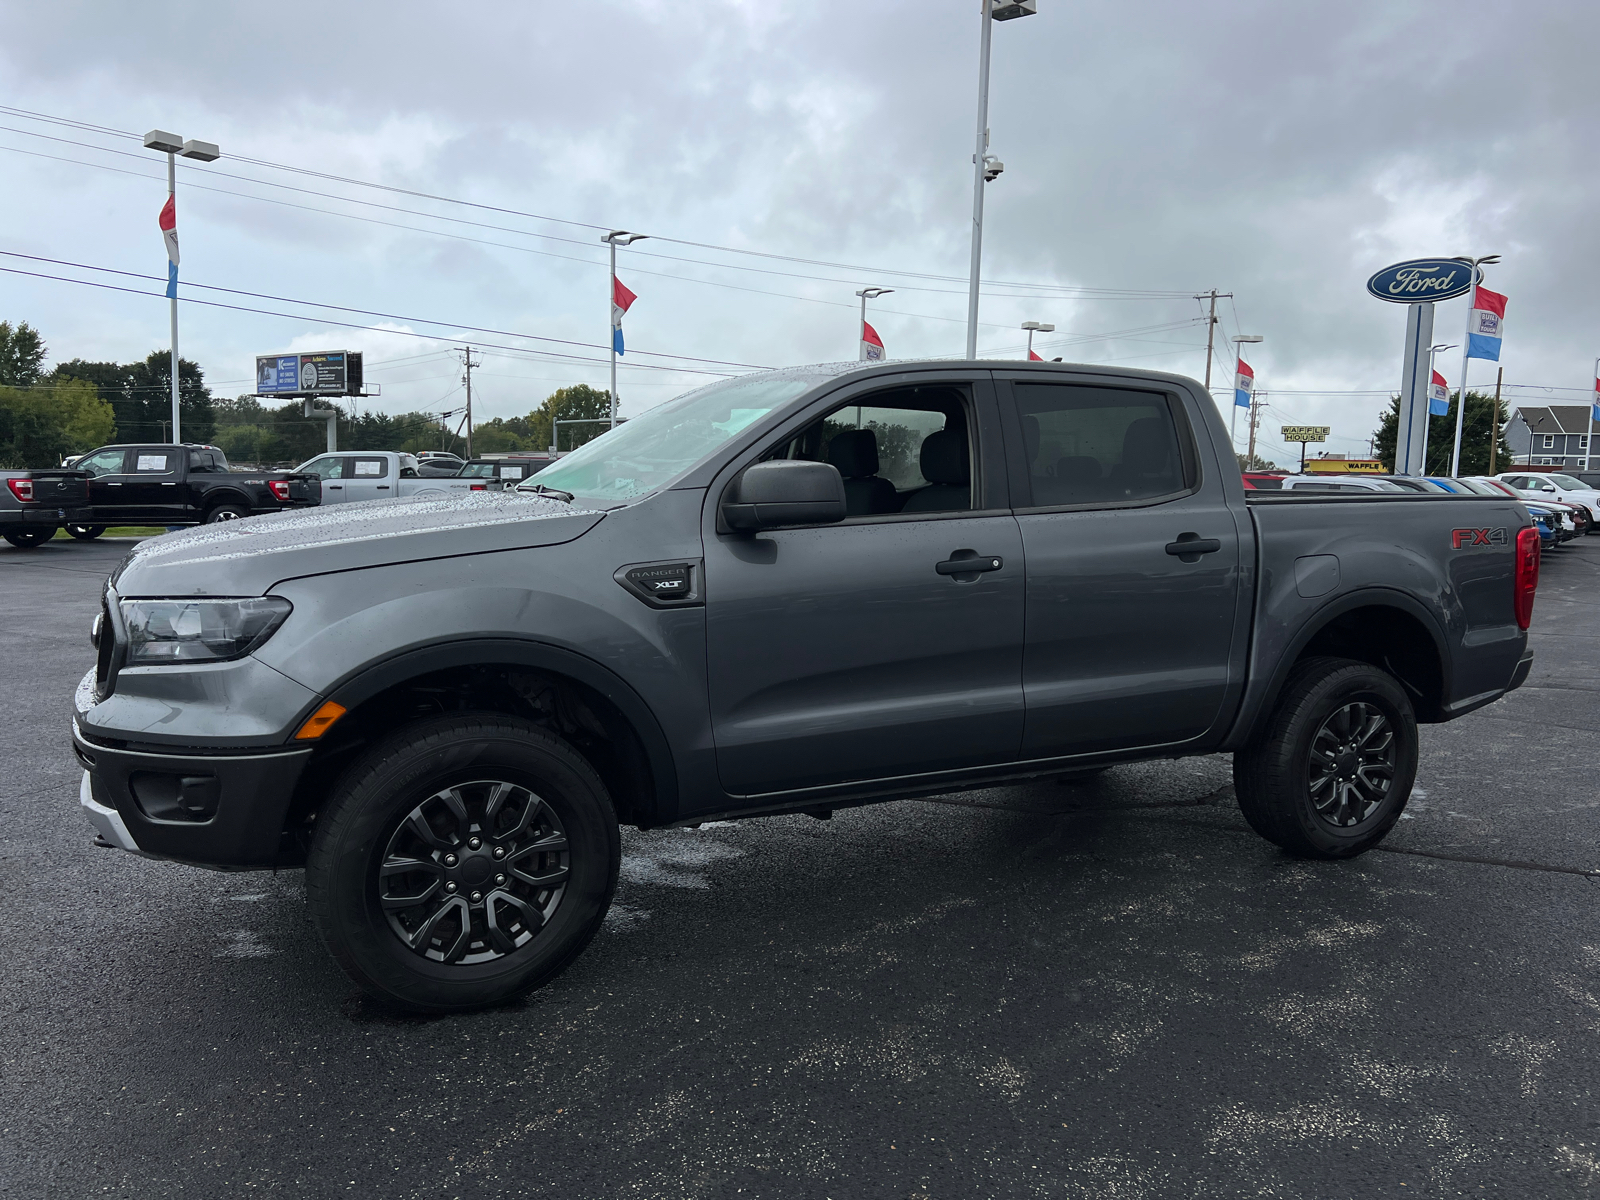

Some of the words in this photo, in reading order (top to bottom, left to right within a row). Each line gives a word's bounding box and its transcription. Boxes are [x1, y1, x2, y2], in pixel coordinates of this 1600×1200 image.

[1389, 266, 1457, 294] Ford
[1481, 313, 1498, 322] BUILT
[1451, 527, 1508, 550] FX4
[632, 569, 685, 578] RANGER
[655, 580, 683, 589] XLT
[379, 791, 393, 805] ALL
[392, 762, 432, 791] WEATHER
